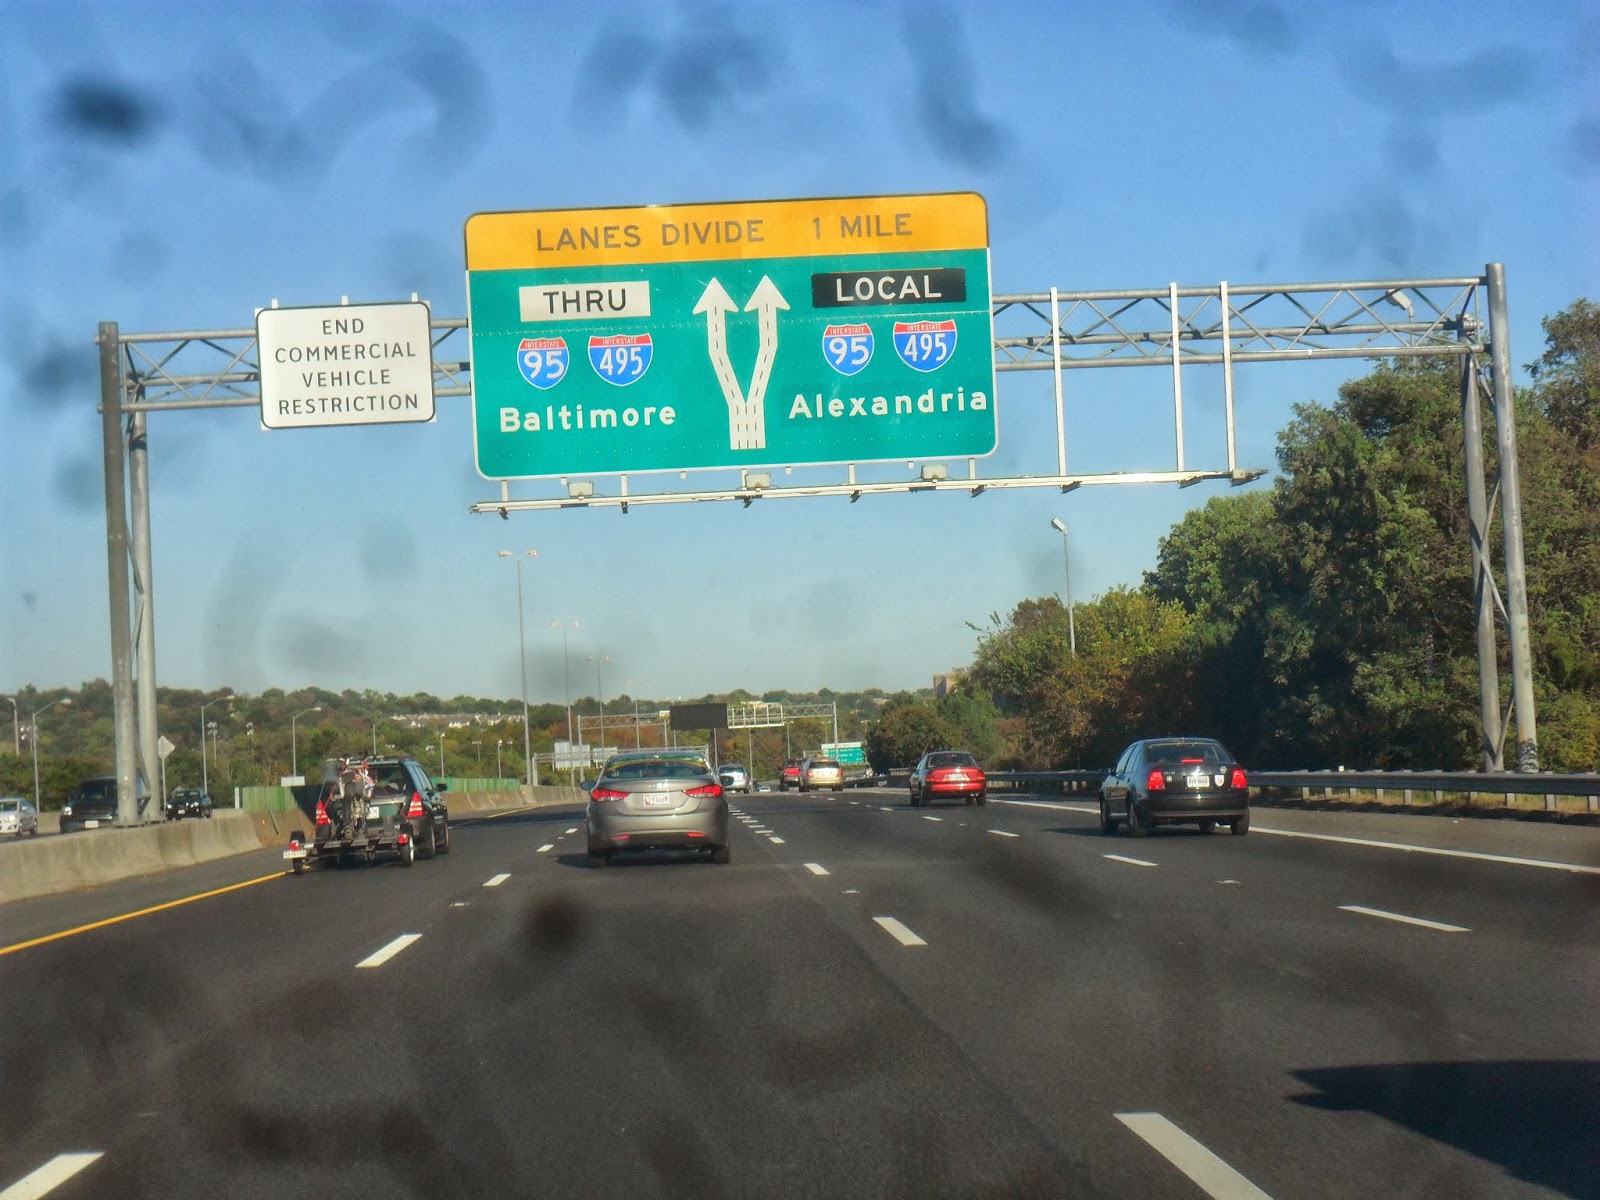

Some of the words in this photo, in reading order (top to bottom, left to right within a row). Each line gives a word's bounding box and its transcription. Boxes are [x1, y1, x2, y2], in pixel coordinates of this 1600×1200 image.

[536, 224, 642, 252] LANES
[661, 219, 765, 246] DIVIDE
[812, 216, 821, 240] 1
[840, 213, 913, 238] MILE
[542, 288, 627, 314] THRU
[836, 274, 942, 302] LOCAL
[322, 318, 365, 335] END
[830, 326, 865, 335] INTERSTATE
[907, 323, 942, 332] INTERSTATE
[275, 342, 416, 364] COMMERCIAL
[524, 340, 560, 348] INTERSTATE
[602, 337, 638, 345] INTERSTATE
[828, 336, 870, 366] 95
[904, 333, 947, 362] 495
[523, 350, 565, 379] 95
[599, 346, 643, 376] 495
[302, 368, 391, 388] VEHICLE
[279, 393, 419, 415] RESTRICTION
[788, 386, 987, 419] Alexandria
[500, 404, 676, 433] Baltimore
